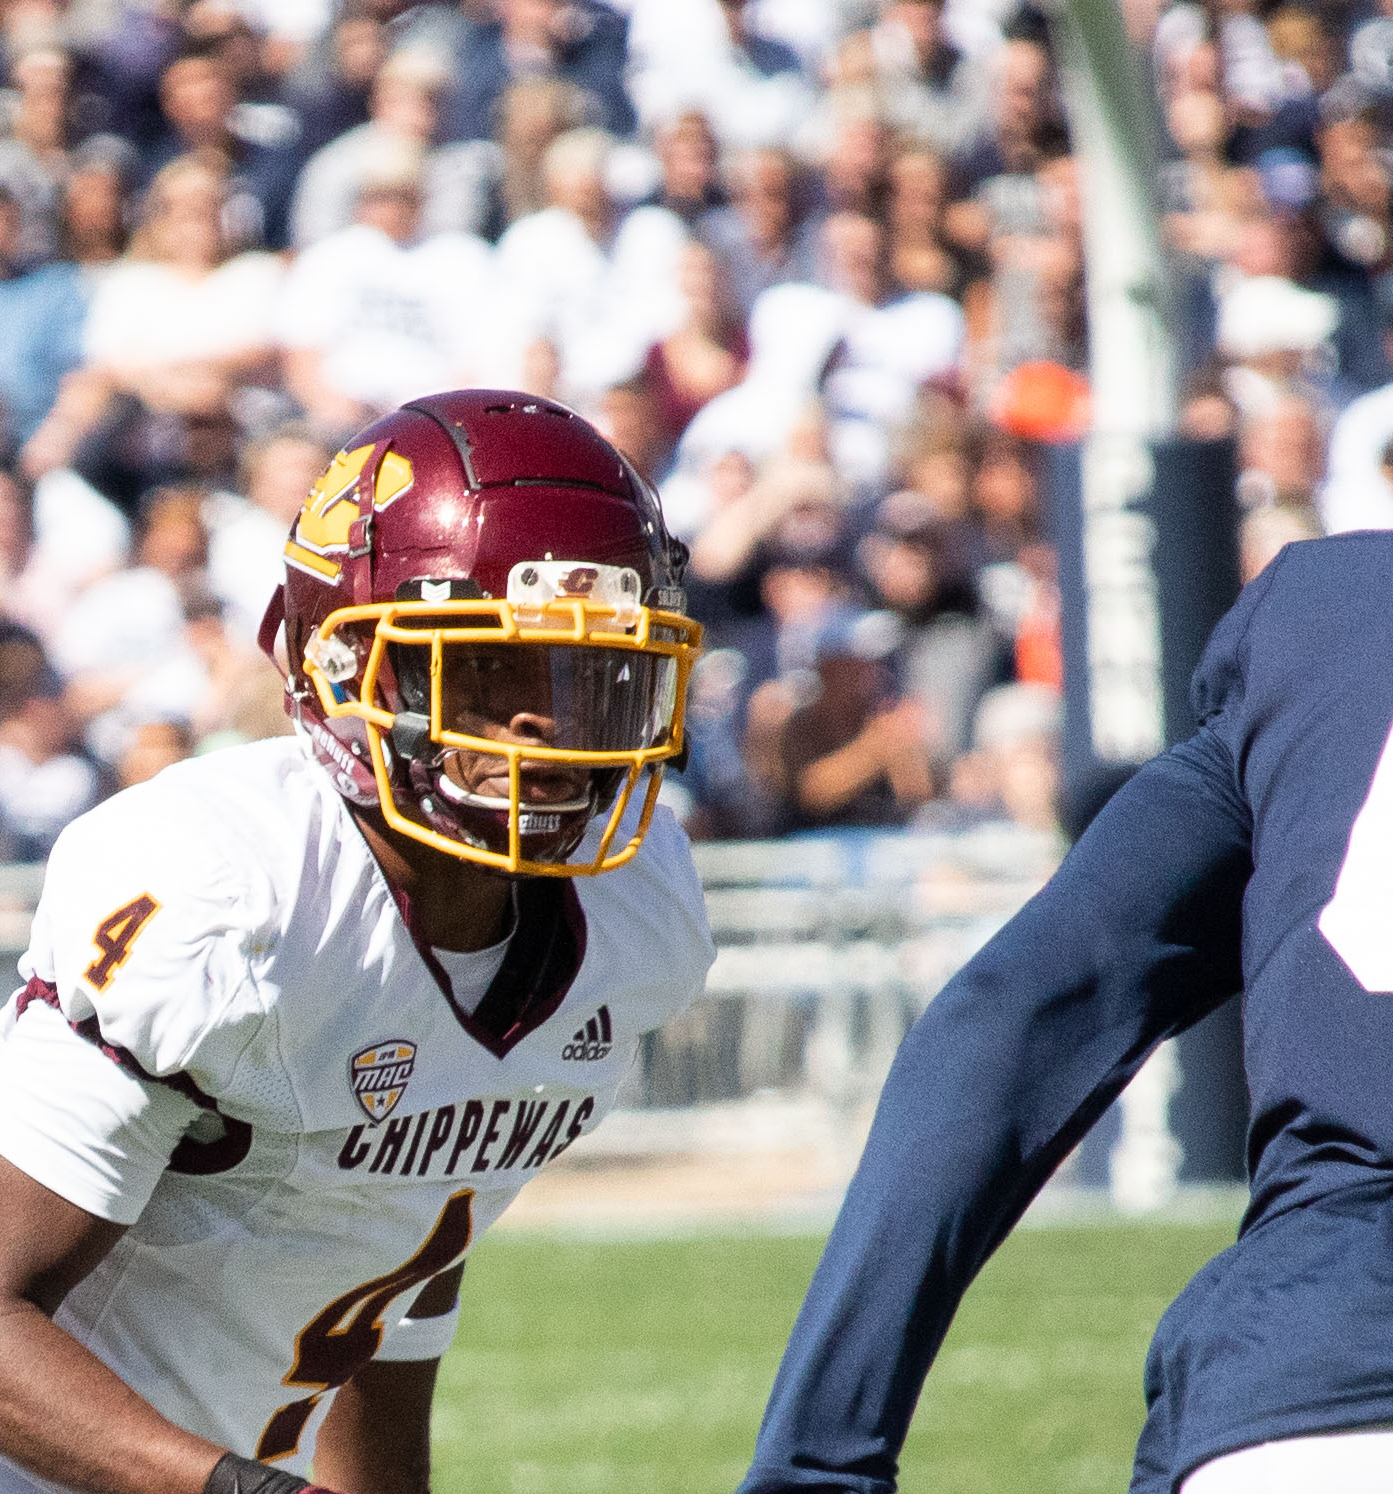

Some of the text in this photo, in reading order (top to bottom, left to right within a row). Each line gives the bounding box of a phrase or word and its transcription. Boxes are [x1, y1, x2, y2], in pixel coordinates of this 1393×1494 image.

[83, 891, 163, 995] 4
[356, 1065, 415, 1093] MAC
[338, 1096, 595, 1177] CHIPPEWAS
